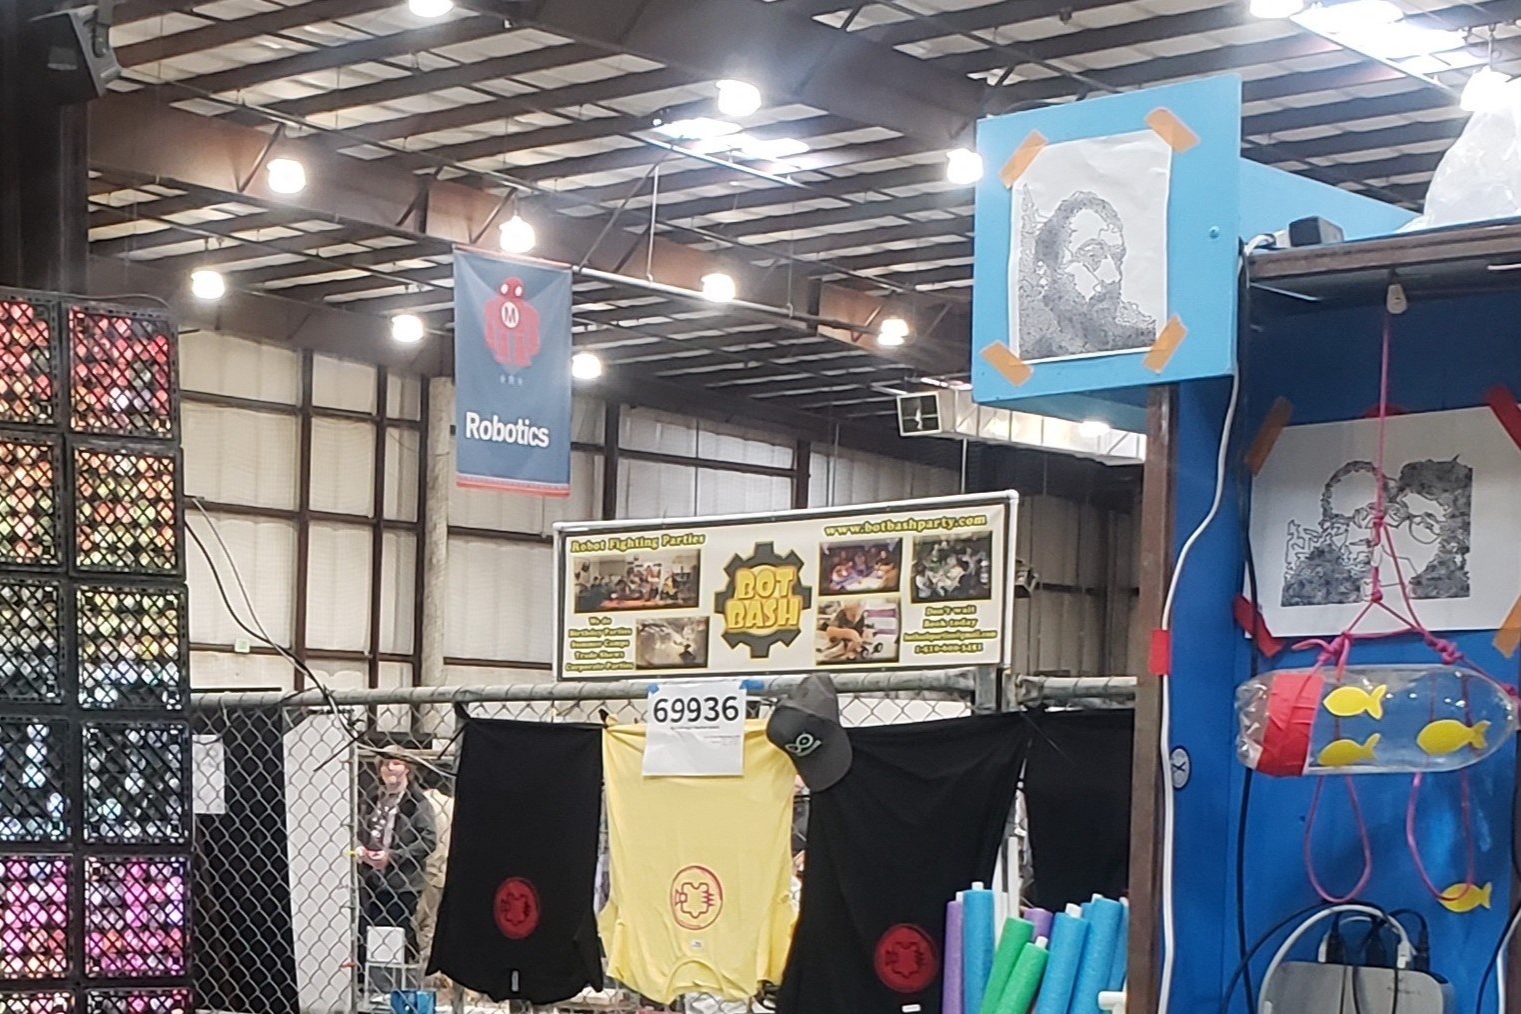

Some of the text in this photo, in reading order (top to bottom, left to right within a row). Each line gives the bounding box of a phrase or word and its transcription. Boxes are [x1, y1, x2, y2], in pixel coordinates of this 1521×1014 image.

[465, 411, 550, 448] Robotics
[825, 515, 987, 536] www.botbashparty.com
[571, 533, 706, 553] Robot Fighting Parties
[735, 567, 794, 600] BOT
[727, 599, 801, 630] BASH
[952, 604, 977, 615] wait
[568, 627, 632, 638] Birthday Parties
[948, 617, 978, 628] today
[574, 651, 599, 660] Trade
[565, 661, 634, 673] Corporate Parties
[653, 696, 740, 723] 69936
